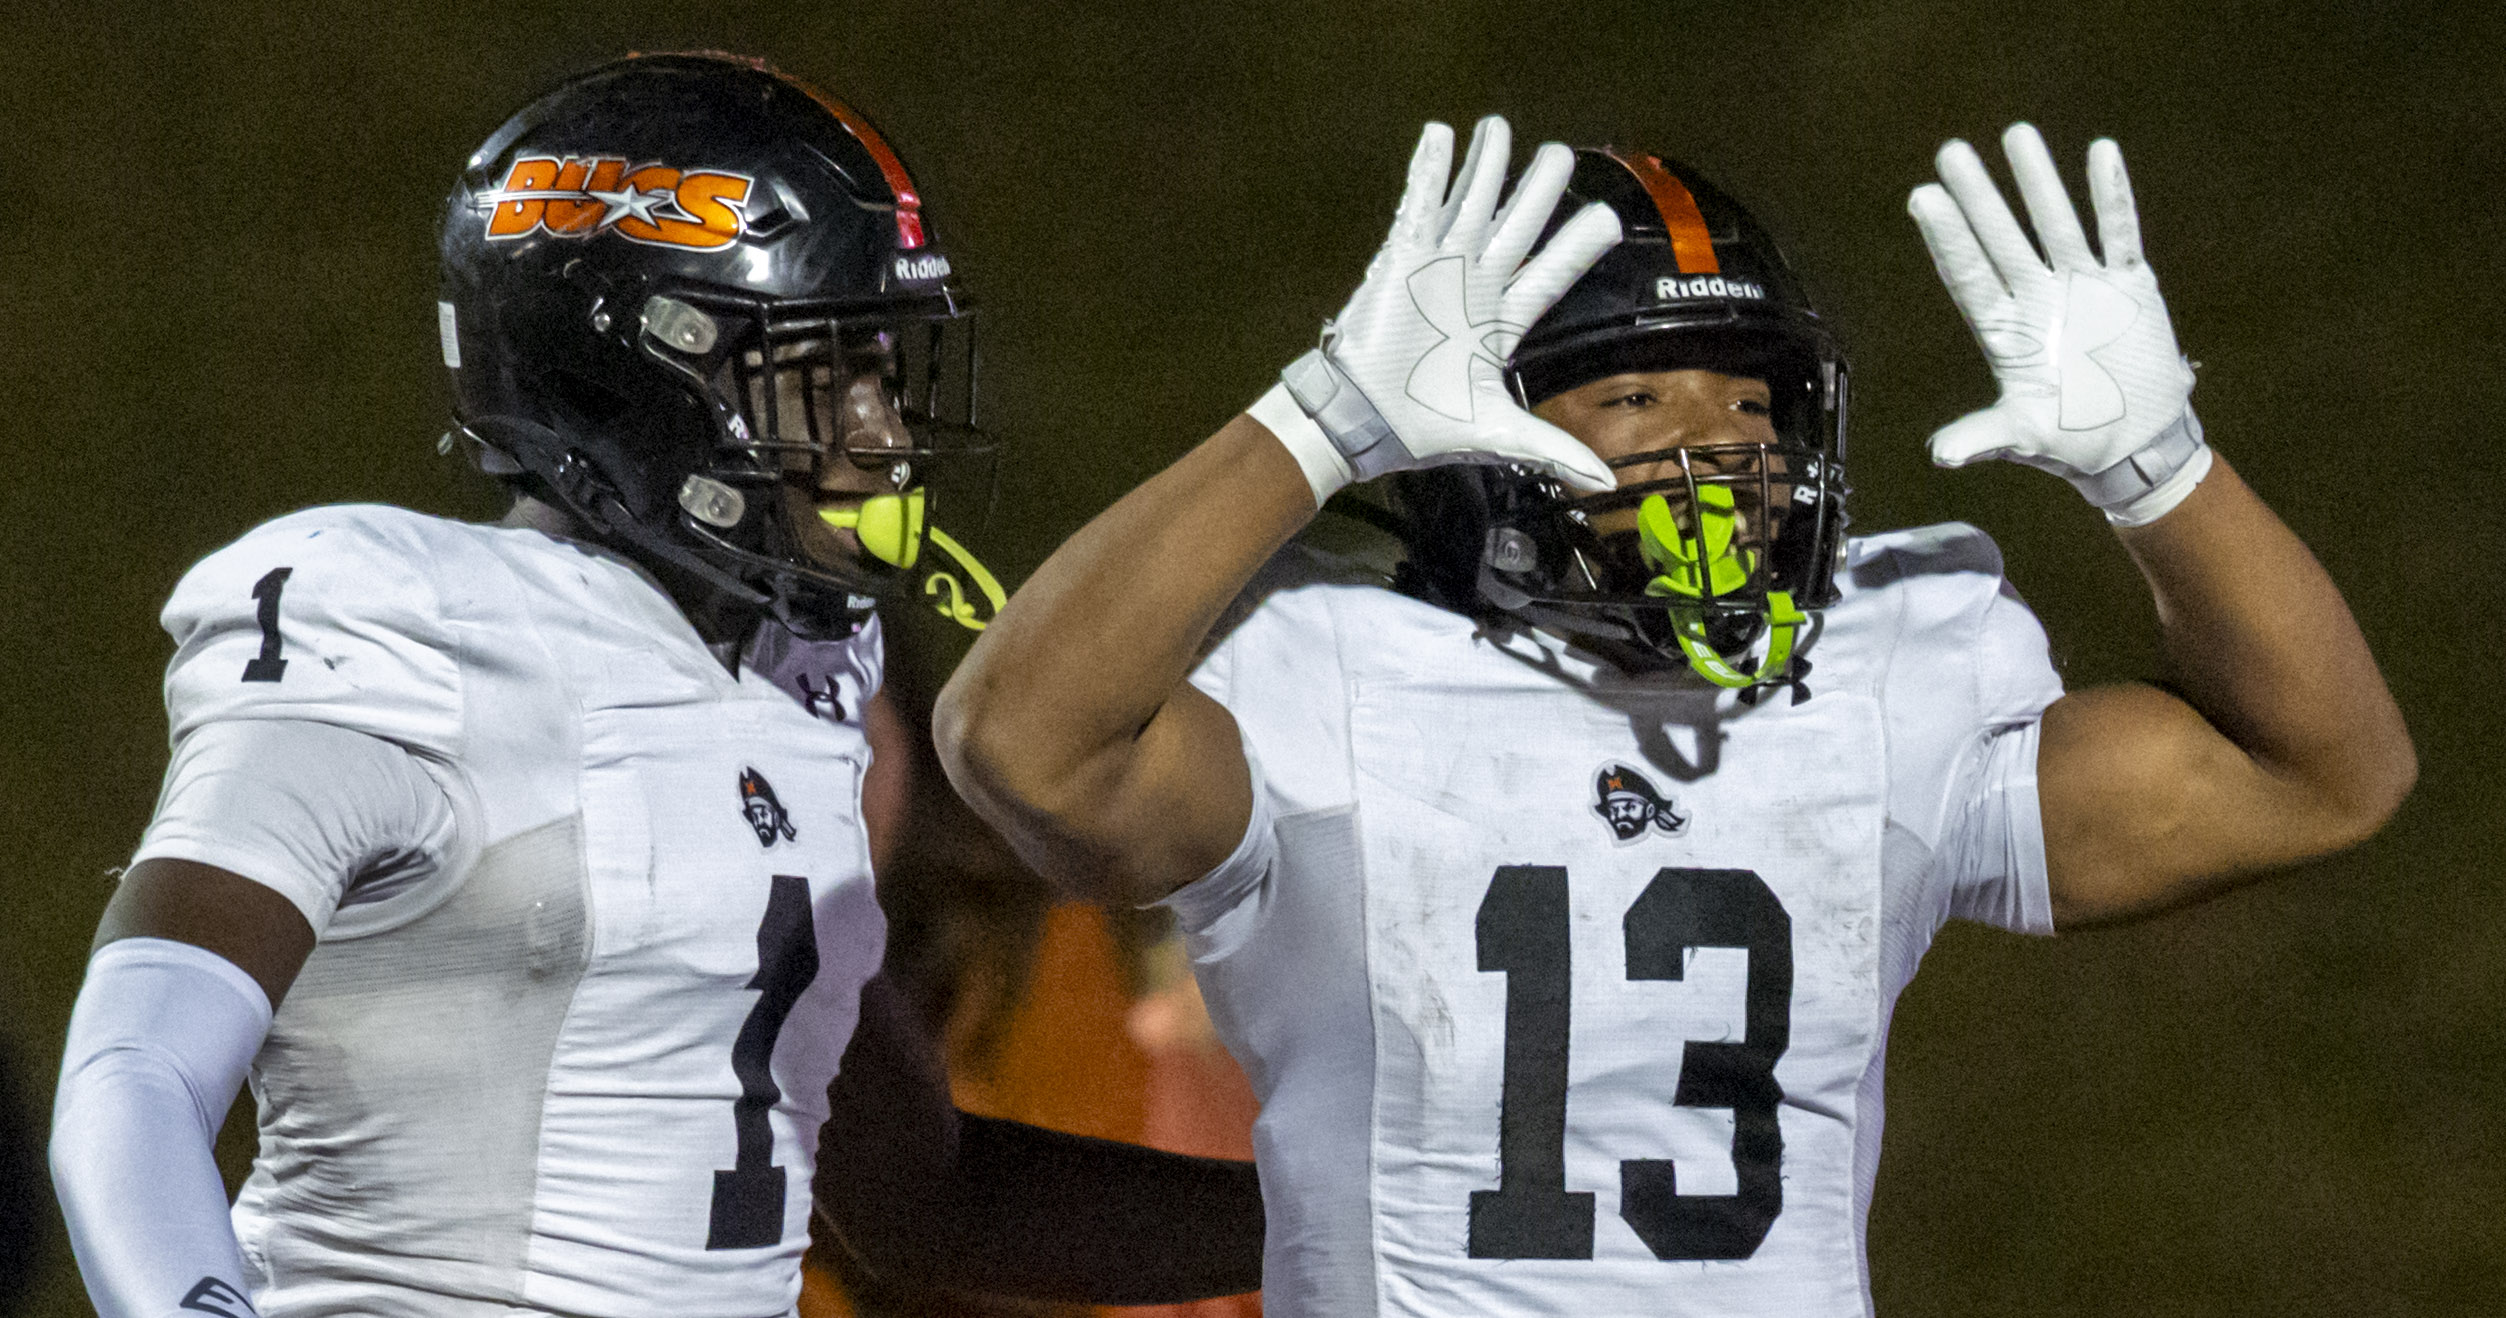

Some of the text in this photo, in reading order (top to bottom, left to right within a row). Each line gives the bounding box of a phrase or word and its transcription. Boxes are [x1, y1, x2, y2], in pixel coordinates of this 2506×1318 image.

[486, 155, 754, 253] BUCS
[241, 567, 293, 682] 1
[705, 875, 820, 1250] 1
[1468, 864, 1794, 1261] 13
